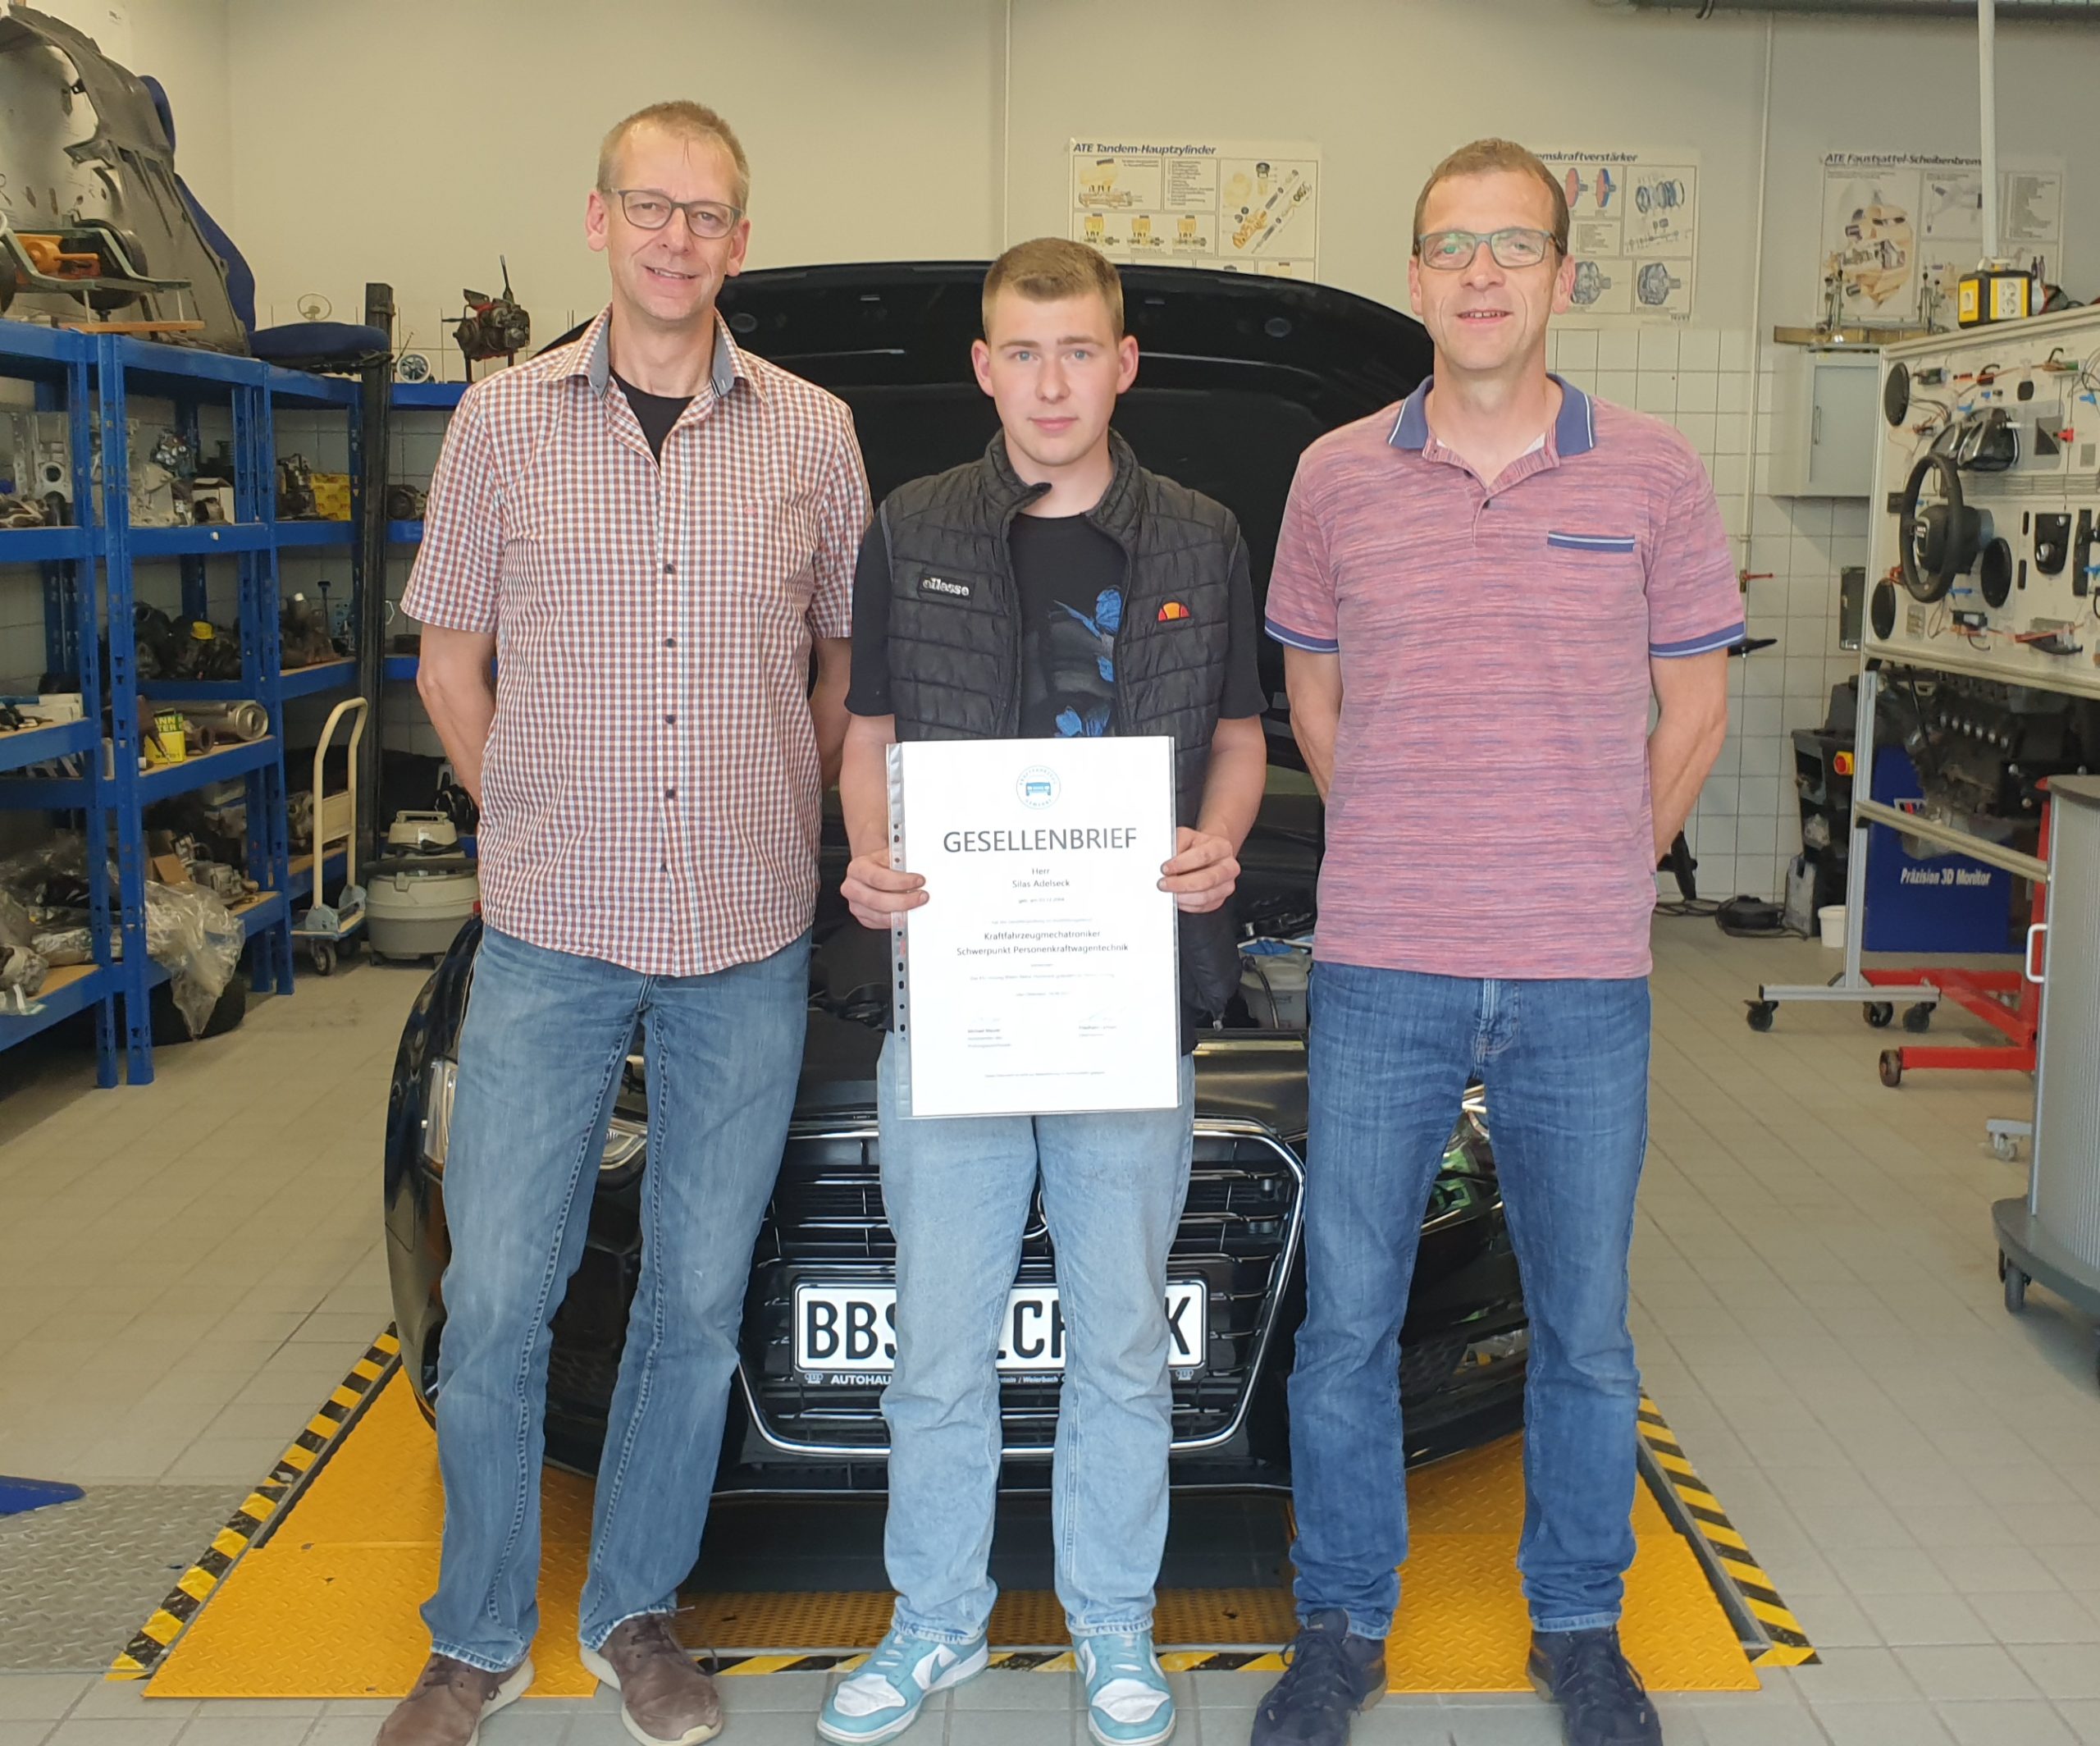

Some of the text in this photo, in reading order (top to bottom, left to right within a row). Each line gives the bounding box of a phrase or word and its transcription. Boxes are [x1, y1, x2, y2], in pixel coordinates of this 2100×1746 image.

[1074, 143, 1217, 156] ATE Tandem-Hauptzylinder
[1825, 153, 1845, 164] ATE
[943, 827, 1138, 852] GESELLENBRIEF
[1031, 867, 1050, 875] Herr
[1900, 866, 1992, 886] Präzision 3D Monitor
[1012, 880, 1031, 889] Silas
[984, 930, 1101, 941] Kraftfahrzeugmechatroniker
[956, 944, 1129, 957] Schwerpunkt Personenkraftwagentechnik
